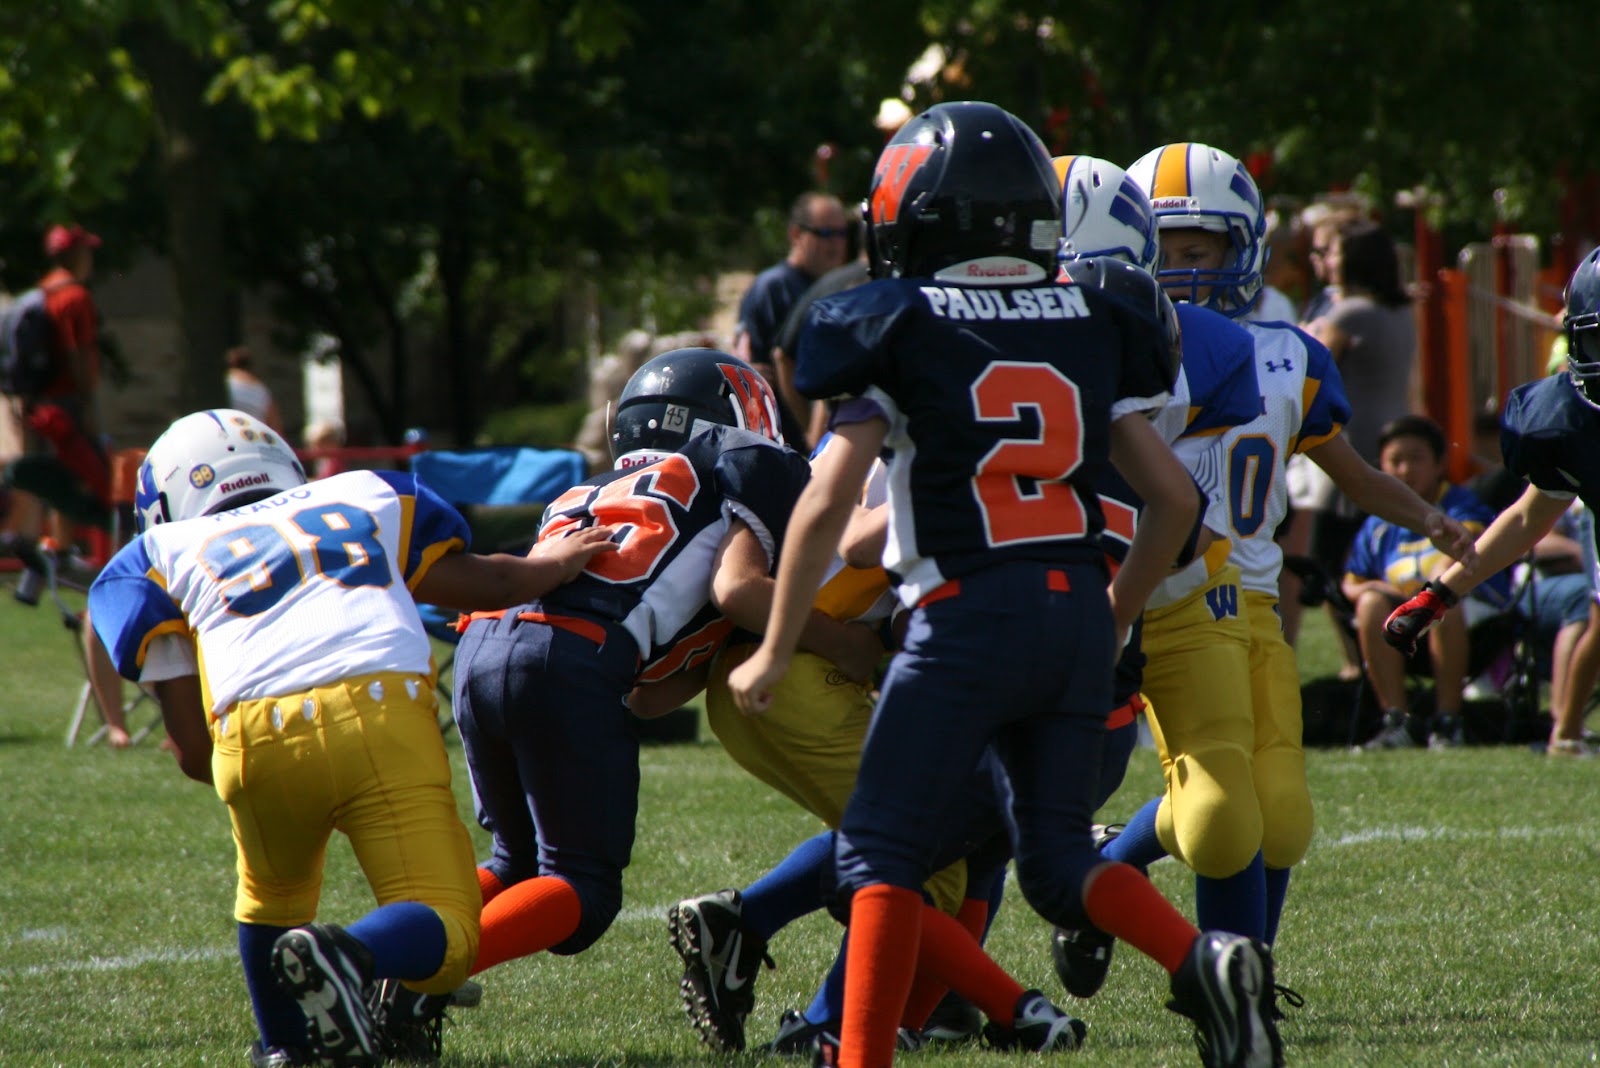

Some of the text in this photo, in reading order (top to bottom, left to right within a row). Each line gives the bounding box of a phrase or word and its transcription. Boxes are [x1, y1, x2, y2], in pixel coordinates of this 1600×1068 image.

[1153, 199, 1187, 209] Riddell
[967, 263, 1028, 277] Riddell
[920, 286, 1091, 320] PAULSEN
[666, 407, 684, 426] 45
[970, 360, 1087, 547] 2
[192, 465, 214, 487] 98
[219, 473, 271, 494] Riddell
[196, 501, 394, 619] 98
[1204, 584, 1238, 622] W
